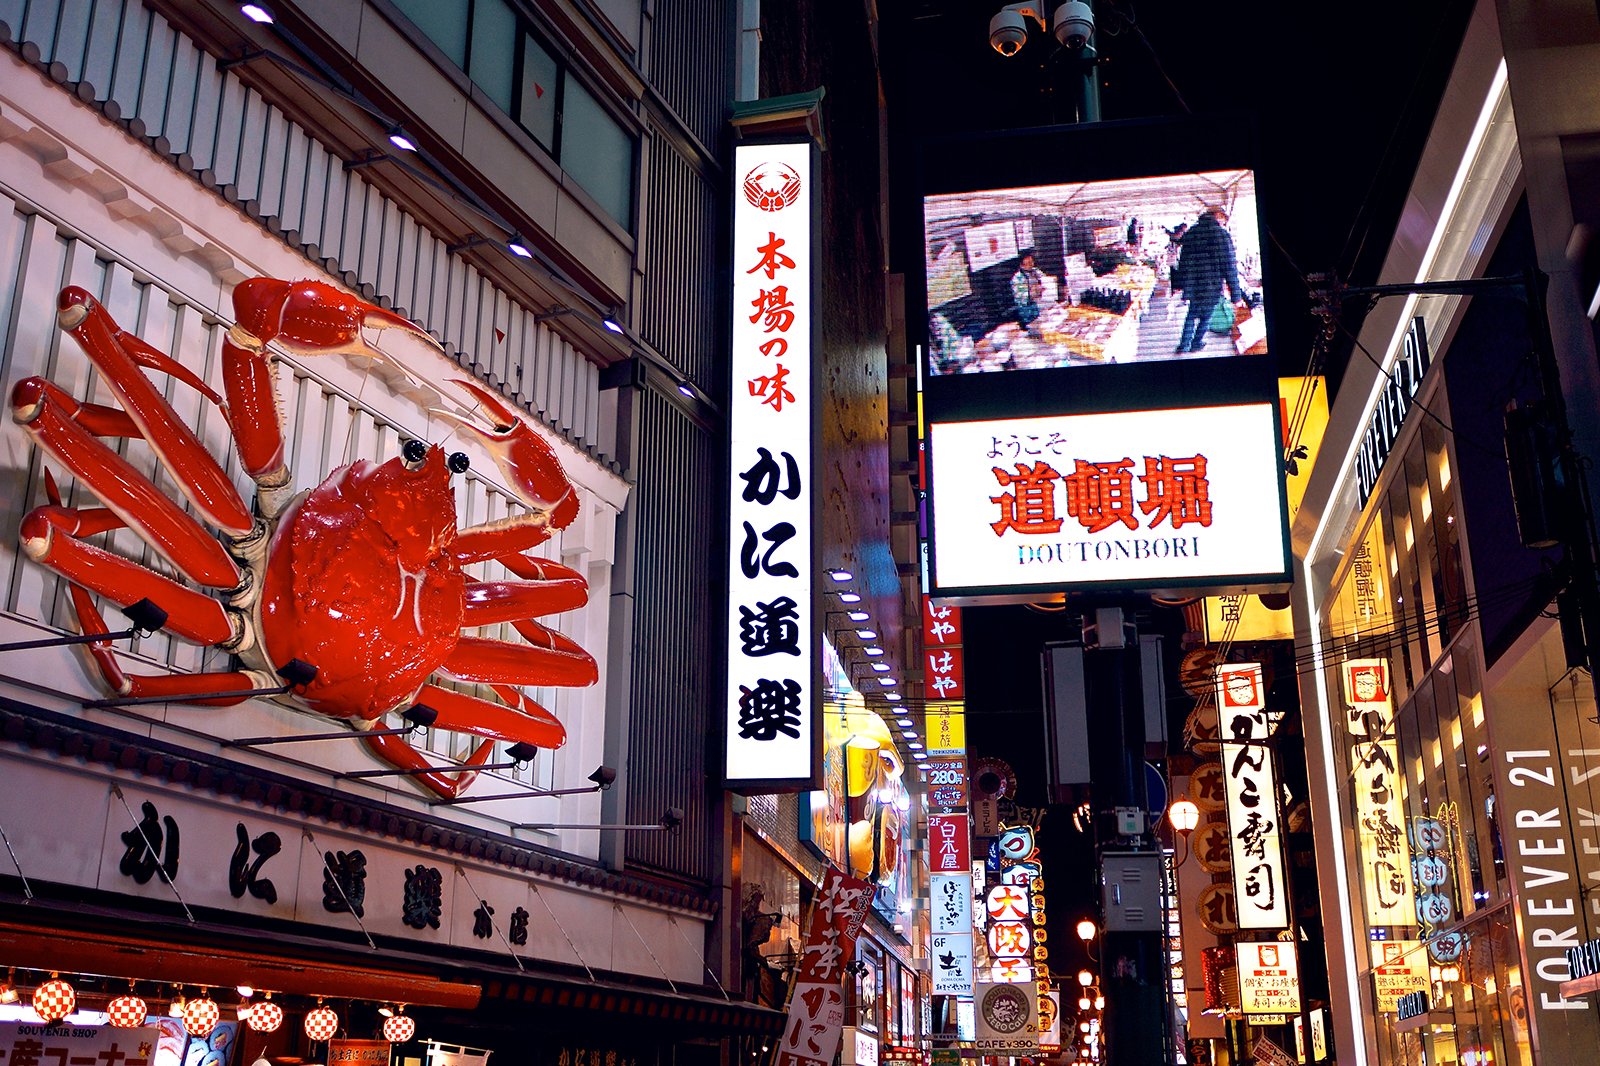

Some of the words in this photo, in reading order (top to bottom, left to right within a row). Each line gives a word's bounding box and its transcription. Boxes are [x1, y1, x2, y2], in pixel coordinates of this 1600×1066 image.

[746, 231, 797, 413] 本場の味
[1354, 359, 1407, 512] FOREVER
[1404, 317, 1423, 398] 21
[986, 432, 1067, 459] ようこそ
[988, 453, 1213, 537] 道頓堀
[1018, 535, 1201, 565] DOUTONBORI
[738, 446, 802, 741] かに道楽
[930, 650, 957, 698] はや
[1506, 750, 1555, 787] 21
[930, 818, 941, 826] 2F
[939, 821, 960, 869] 白木屋
[1515, 807, 1589, 1010] FOREVER
[934, 938, 946, 948] 6F
[17, 1025, 70, 1038] SOUVENIR
[72, 1028, 98, 1039] SHOP
[987, 1014, 1007, 1031] ZERO
[1026, 1024, 1037, 1032] 2F
[976, 1040, 1005, 1048] CAFE
